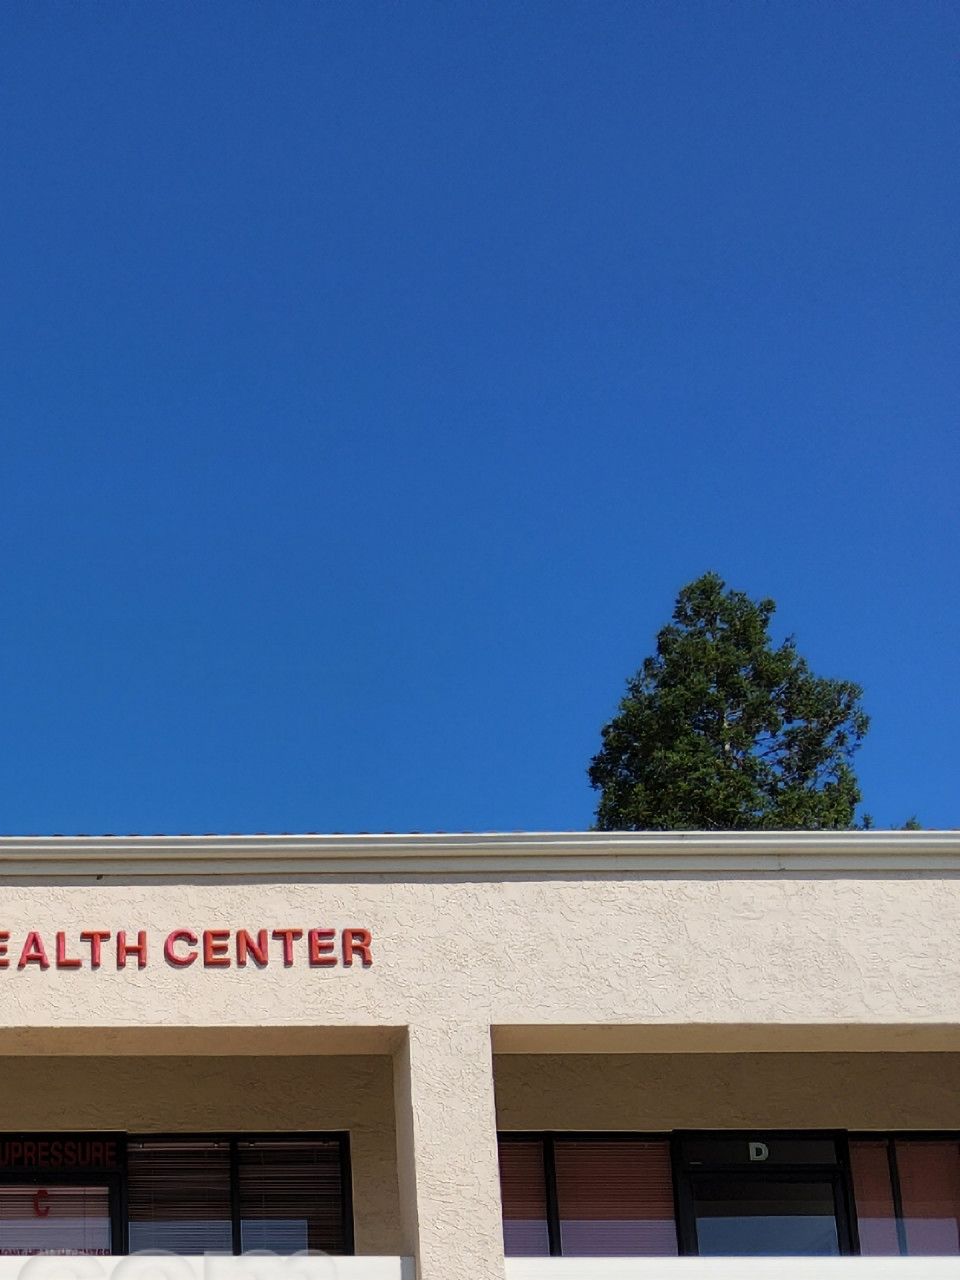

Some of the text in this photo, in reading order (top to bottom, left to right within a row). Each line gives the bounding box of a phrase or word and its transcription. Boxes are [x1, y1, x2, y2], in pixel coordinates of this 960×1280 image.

[164, 928, 373, 969] CENTER
[748, 1142, 769, 1161] D
[32, 1189, 51, 1217] C
